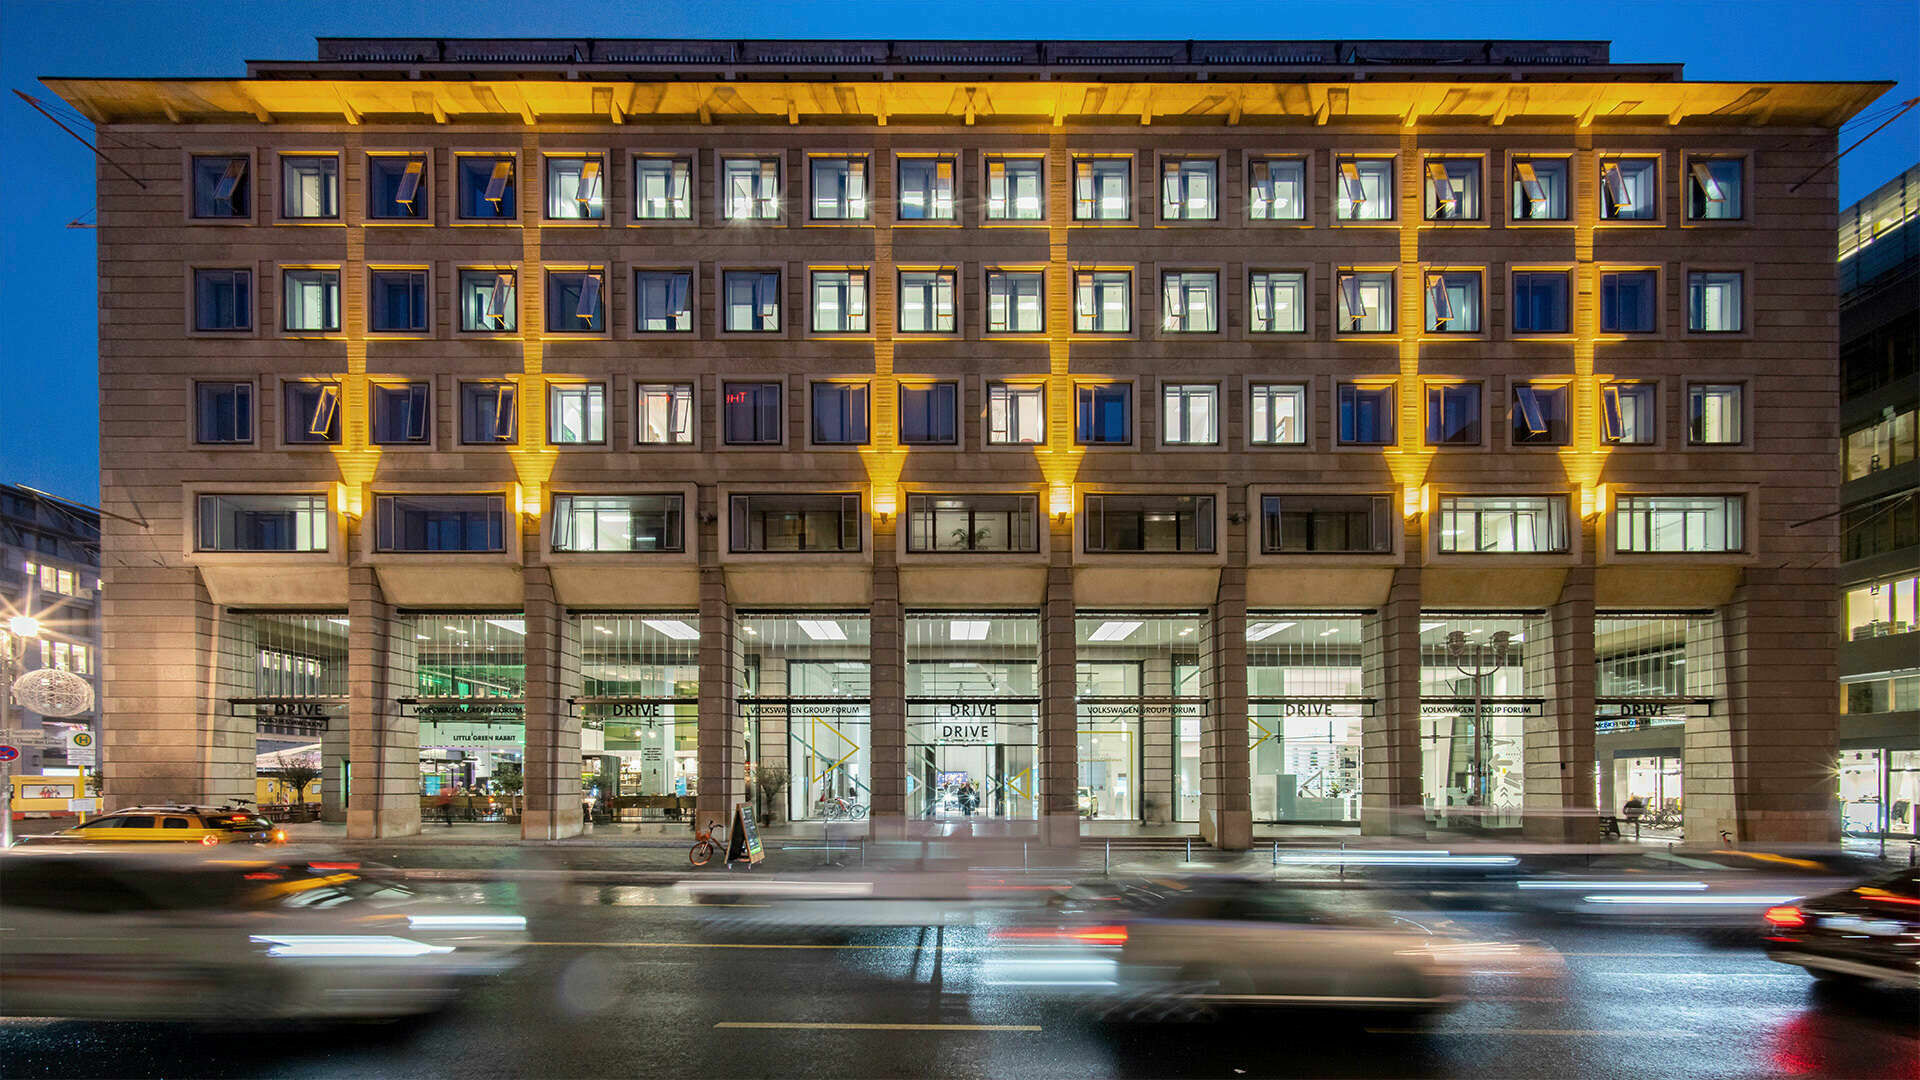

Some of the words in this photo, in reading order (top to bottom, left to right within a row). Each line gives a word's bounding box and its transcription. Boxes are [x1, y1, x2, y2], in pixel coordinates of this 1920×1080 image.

[275, 704, 322, 716] DRIVE
[413, 706, 464, 714] VOLKSWAGEN
[494, 706, 523, 714] FORUM
[613, 703, 660, 717] DRIVE
[750, 706, 801, 714] VOLKSWAGEN
[803, 706, 830, 714] GROUP
[832, 706, 859, 714] FORUM
[950, 703, 996, 717] DRIVE
[1087, 706, 1139, 714] VOLKSWAGEN
[1141, 706, 1167, 714] GROUP
[1169, 706, 1196, 714] FORUM
[1286, 703, 1332, 717] DRIVE
[1422, 706, 1474, 714] VOLKSWAGEN
[1480, 706, 1501, 714] ROUP
[1503, 706, 1532, 714] FORUM
[1621, 703, 1667, 717] DRIVE
[943, 725, 988, 738] DRIVE
